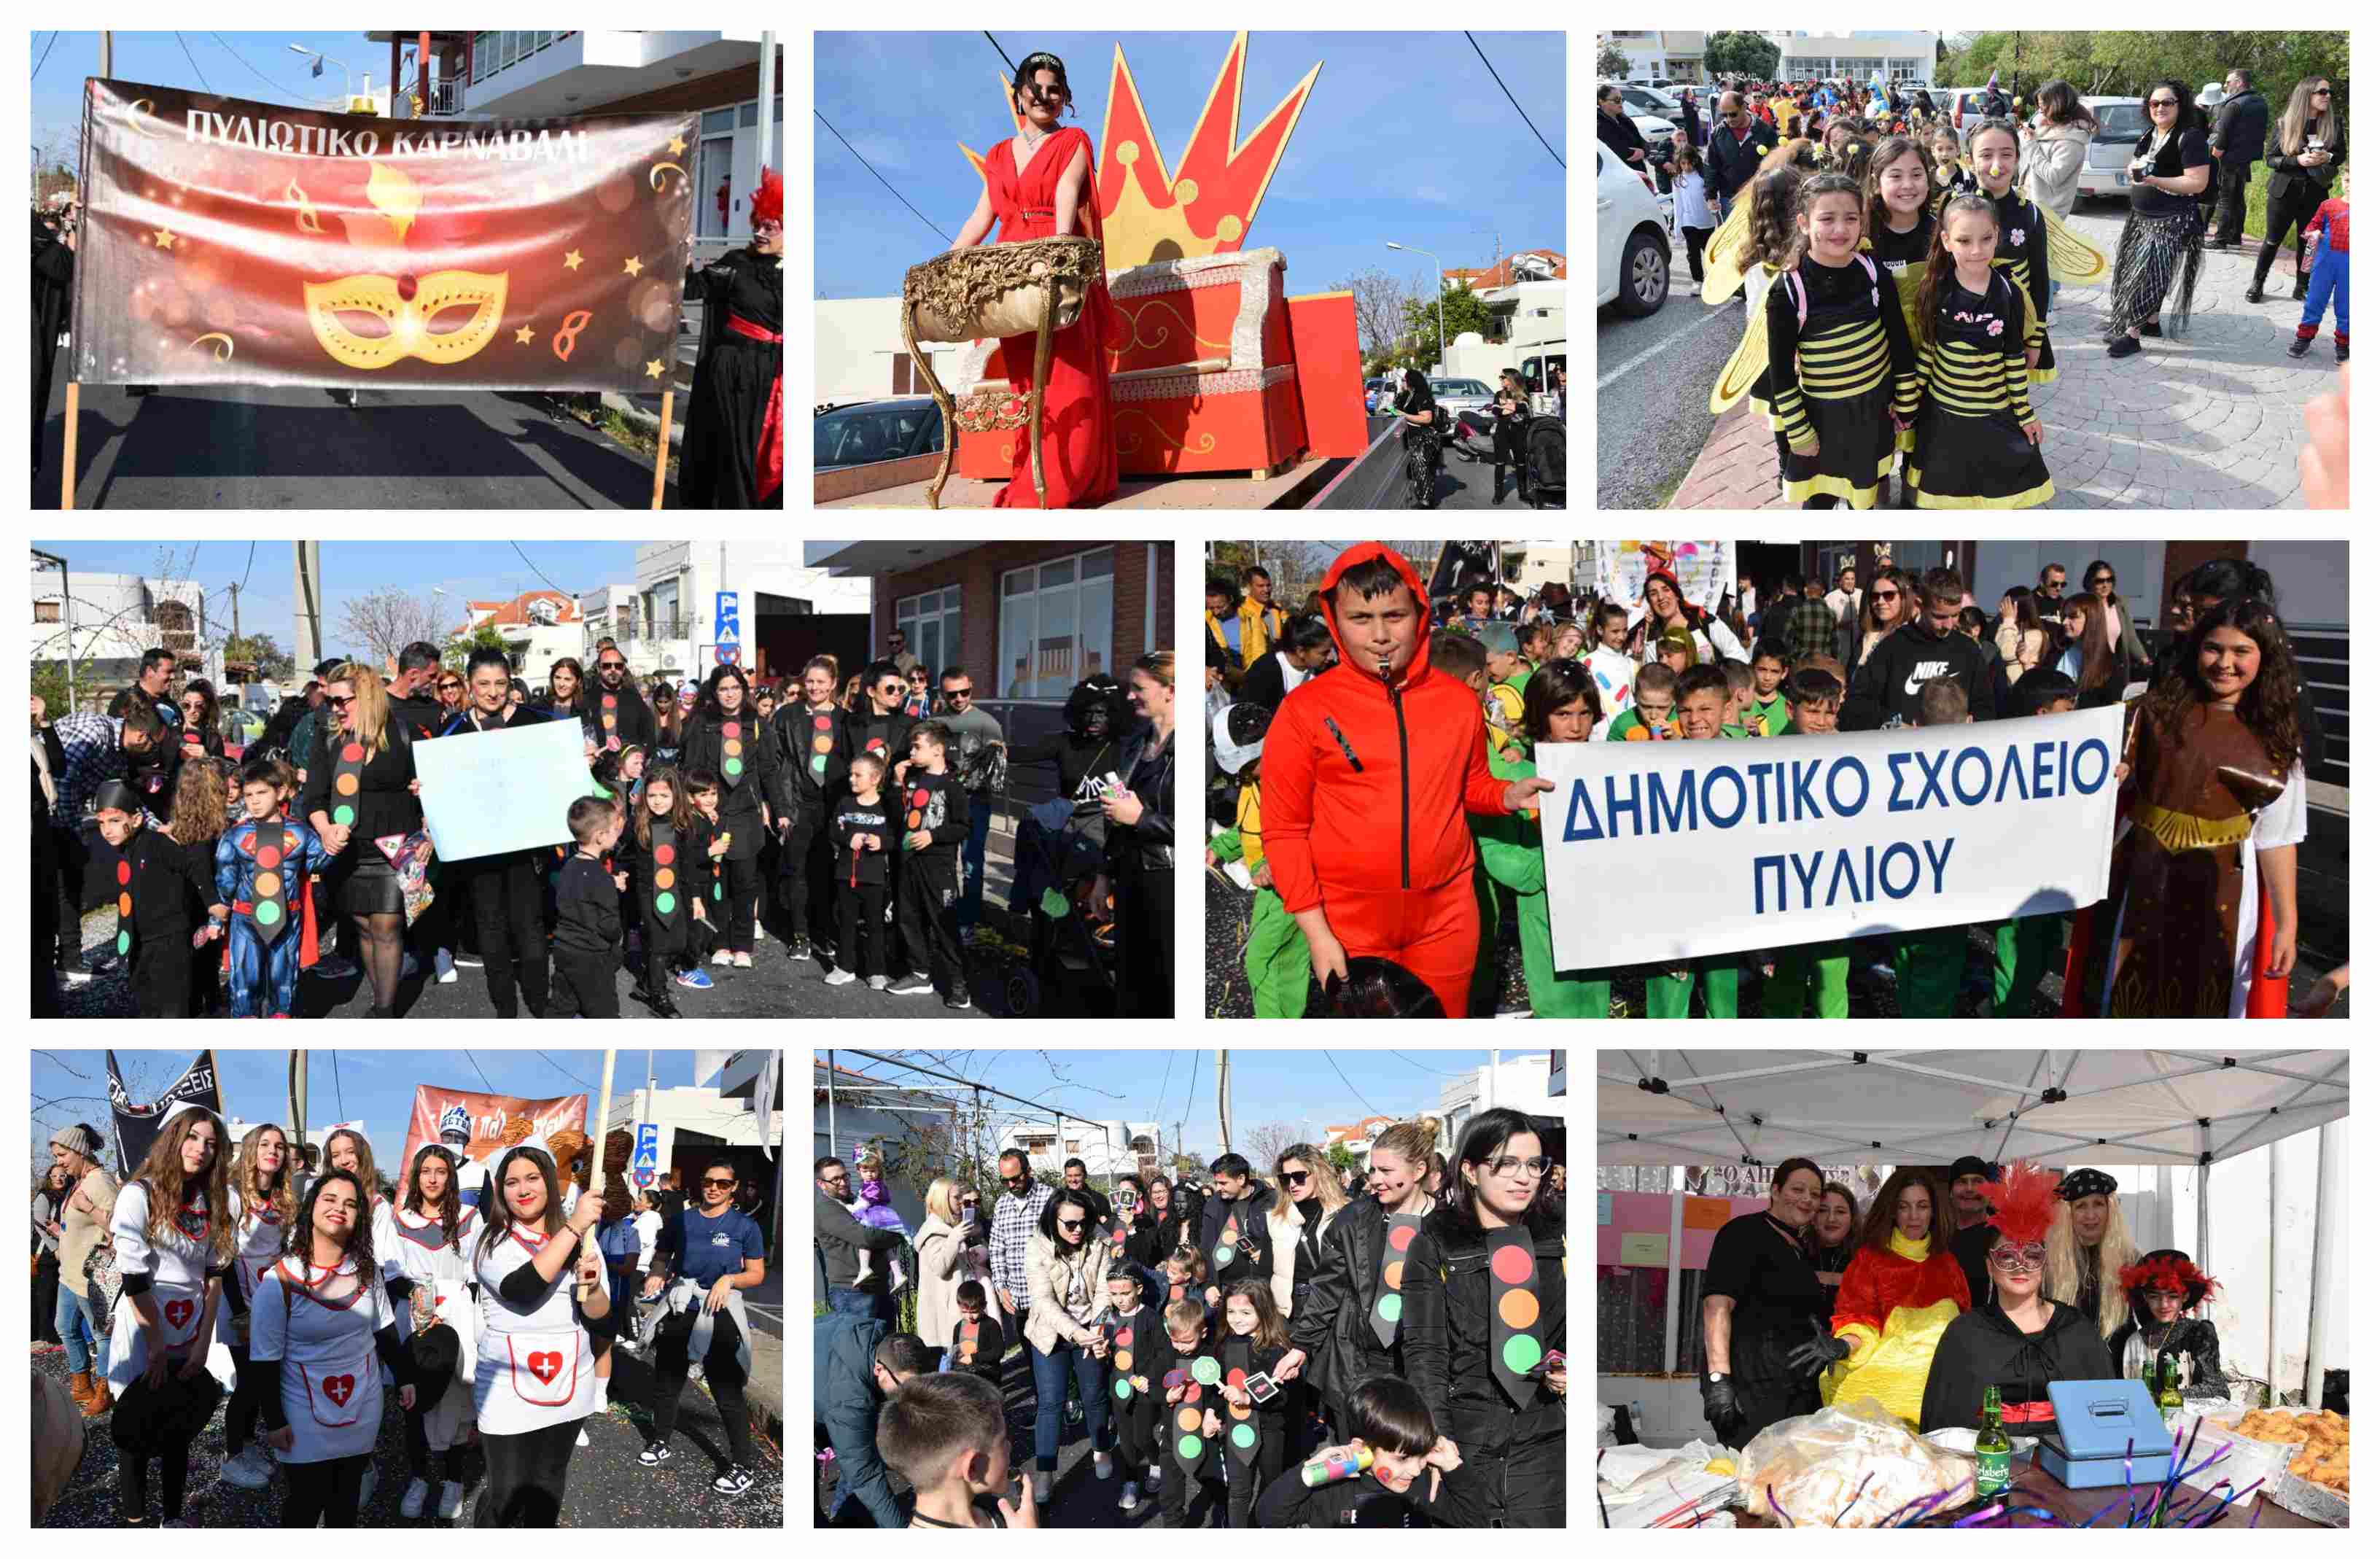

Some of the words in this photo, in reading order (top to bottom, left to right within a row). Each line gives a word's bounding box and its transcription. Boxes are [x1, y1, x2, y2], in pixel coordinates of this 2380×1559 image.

[187, 109, 379, 158] ΠΥΛΙΩΤΙΚΟ
[392, 129, 591, 163] ΚΑΡΝΑΒΑΛΙ
[1912, 661, 1949, 680] NIKE
[1562, 755, 1870, 842] ΔΗΜΟΤΙΚΟ
[1887, 738, 2109, 812] ΣΧΟΛΕΙΟ
[1753, 837, 1955, 914] ΠΥΛΙΟΥ
